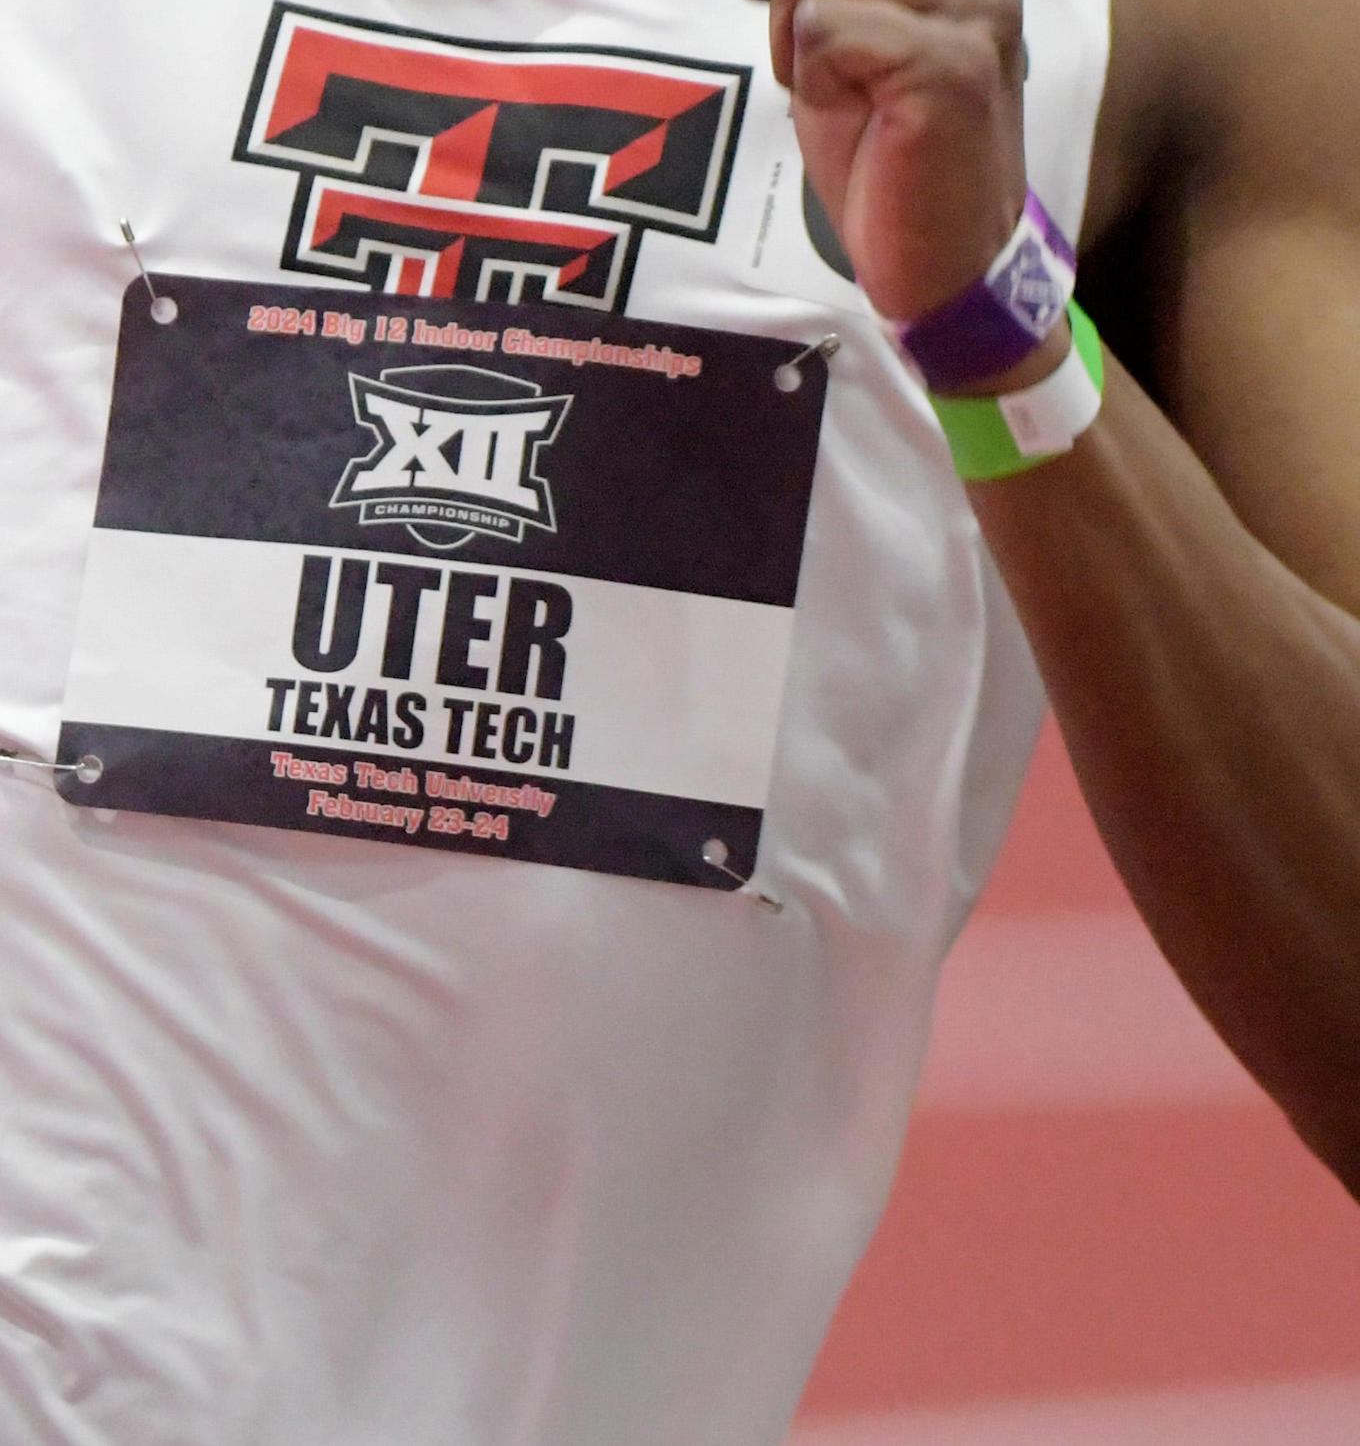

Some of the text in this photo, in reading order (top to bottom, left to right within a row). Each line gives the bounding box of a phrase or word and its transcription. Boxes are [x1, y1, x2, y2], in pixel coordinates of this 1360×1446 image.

[247, 305, 702, 379] 2024 Big 12 Indoor Championships
[351, 393, 552, 512] XII
[374, 504, 511, 528] CHAMPIONSHIP
[292, 554, 573, 701] UTER
[266, 677, 575, 769] TEXAS TECH
[271, 751, 557, 817] Texas Tech University
[307, 789, 509, 841] February 23-24
